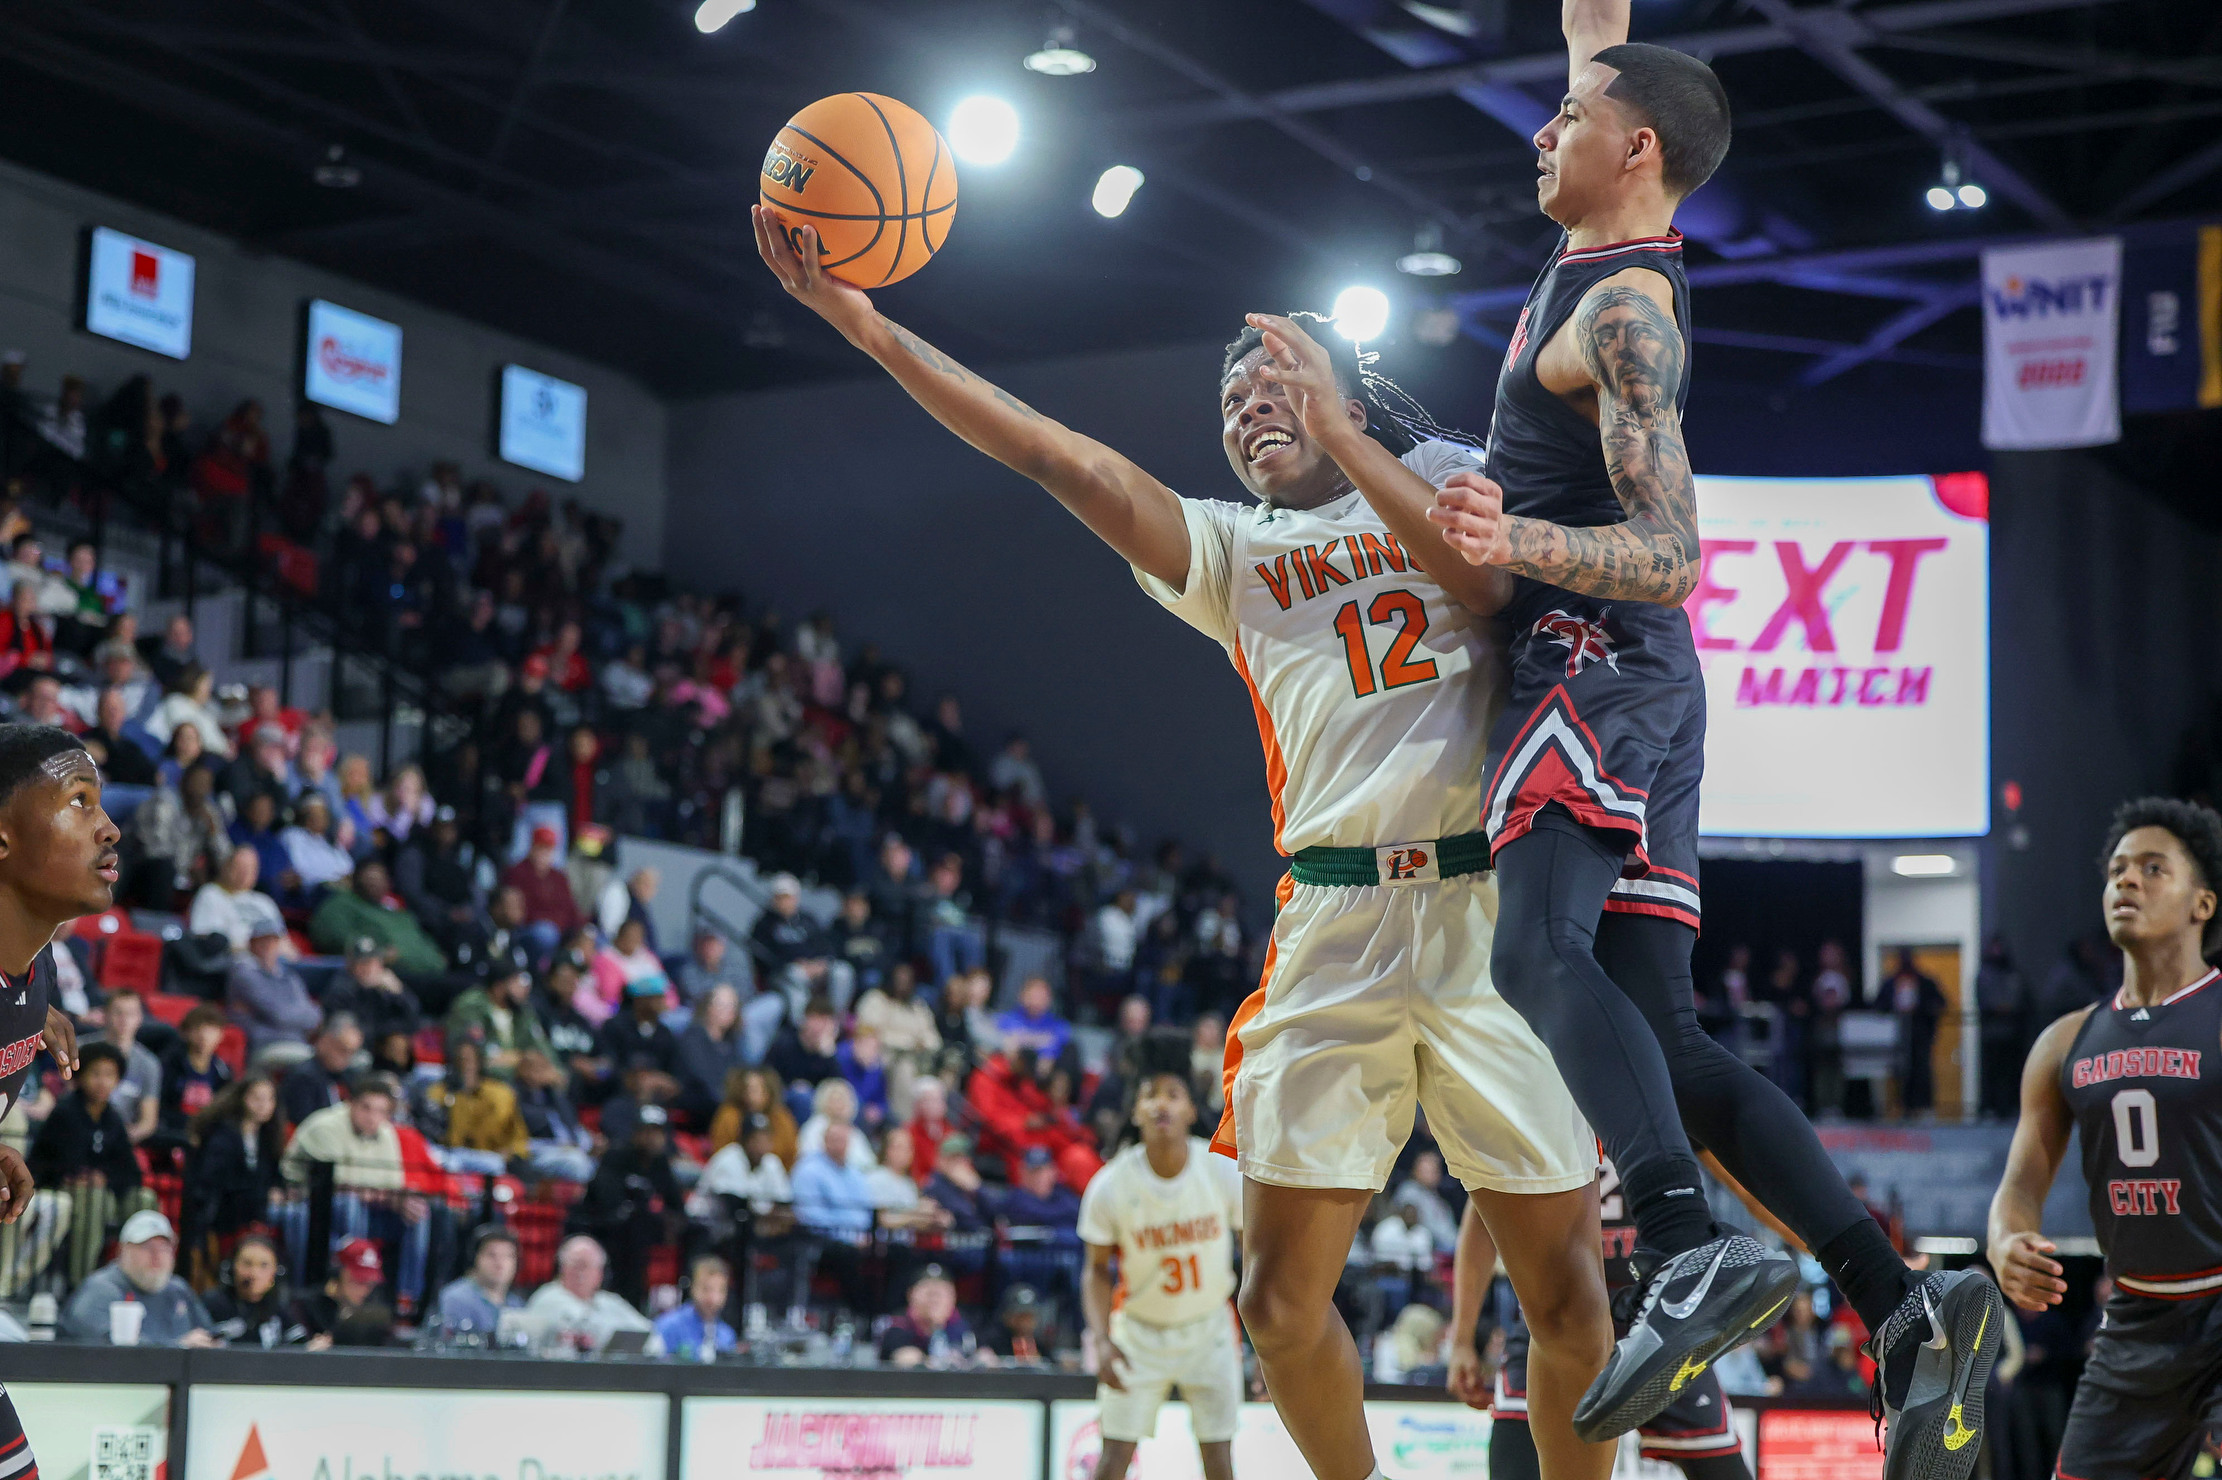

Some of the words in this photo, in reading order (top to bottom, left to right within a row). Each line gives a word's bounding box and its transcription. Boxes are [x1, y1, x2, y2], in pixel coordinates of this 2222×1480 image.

[1254, 531, 1427, 611] VIKIN
[1694, 536, 1949, 653] EXT
[1332, 588, 1440, 700] 12
[1736, 666, 1934, 707] MATCH
[2072, 1047, 2202, 1089] GADSDEN
[2111, 1088, 2160, 1168] 0
[2108, 1179, 2181, 1215] CITY
[1131, 1215, 1222, 1250] VIKINGS
[1601, 1225, 1637, 1259] TY
[1160, 1254, 1202, 1296] 31
